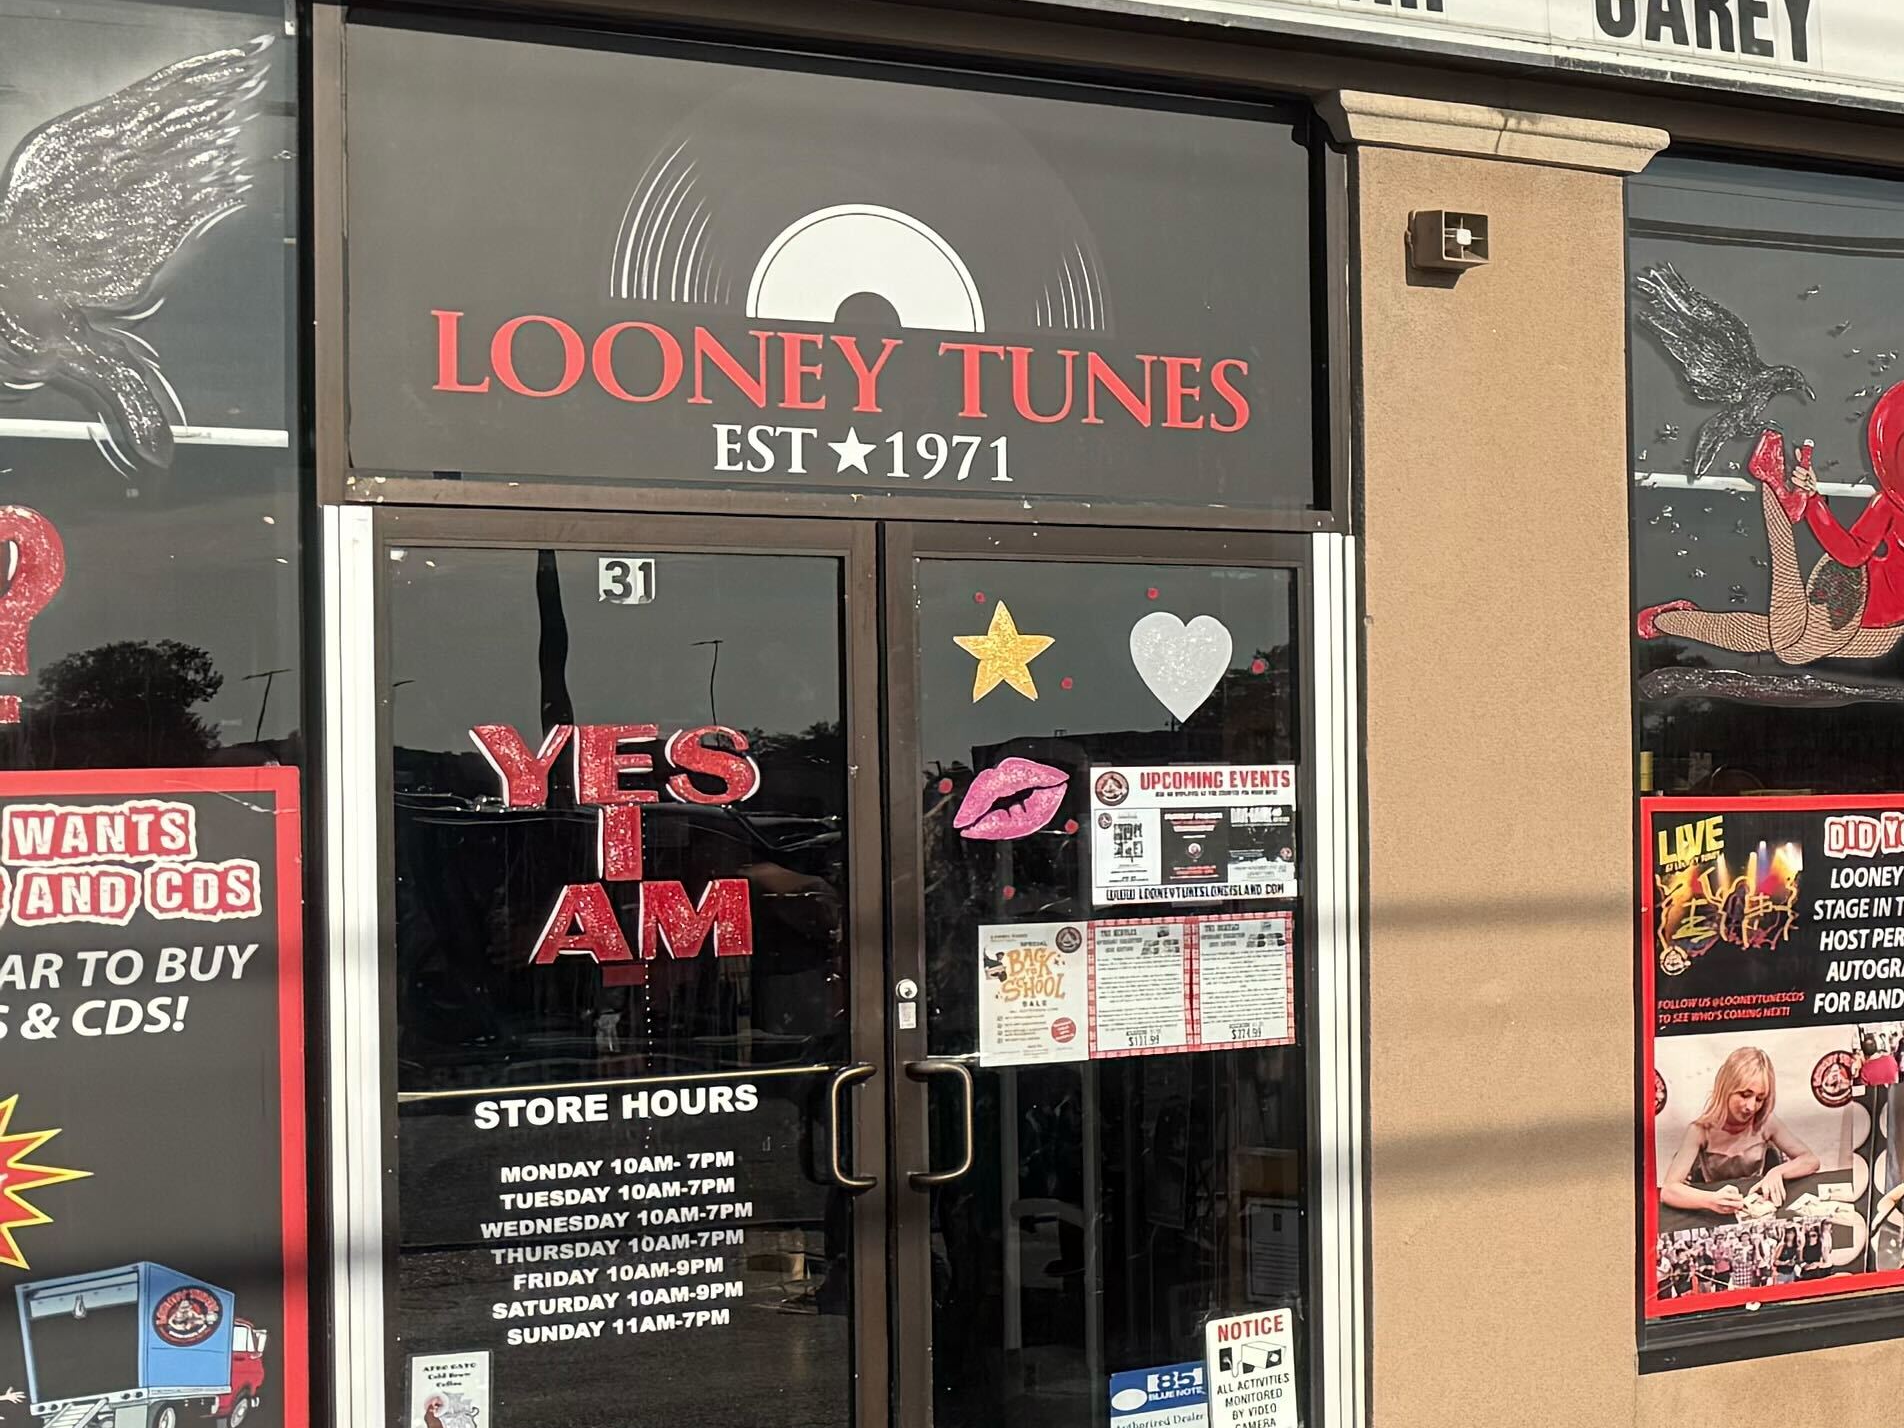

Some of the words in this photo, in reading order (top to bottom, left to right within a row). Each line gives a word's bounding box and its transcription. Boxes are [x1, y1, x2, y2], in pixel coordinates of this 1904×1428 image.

[429, 309, 904, 415] LOONEY
[937, 341, 1250, 433] TUNES
[711, 423, 818, 475] EST
[885, 430, 1014, 483] 1971
[602, 559, 655, 603] 31
[468, 723, 761, 808] YES
[1139, 770, 1224, 791] UPCOMING
[1229, 769, 1291, 789] EVENTS
[11, 809, 191, 858] WANTS
[597, 804, 643, 882] I
[1658, 814, 1725, 865] LIVE
[1828, 819, 1880, 853] DID
[25, 871, 132, 916] AND
[148, 866, 256, 912] CDS
[1830, 865, 1904, 890] LOONEY
[528, 878, 753, 965] AM
[1813, 895, 1871, 921] STAGE
[1873, 895, 1894, 918] IN
[1819, 927, 1871, 952] HOST
[77, 948, 146, 988] TO
[155, 943, 259, 984] BUY
[1006, 947, 1057, 978] BACK
[1001, 972, 1066, 1003] SCHOOL
[1658, 997, 1698, 1010] FOLLOW
[1813, 992, 1851, 1015] FOR
[20, 1001, 61, 1040] &
[71, 995, 190, 1037] CDS!
[473, 1093, 609, 1130] STORE
[621, 1083, 759, 1120] HOURS
[500, 1159, 603, 1184] MONDAY
[610, 1154, 681, 1176] 10AM-
[687, 1150, 735, 1171] 7PM
[499, 1186, 611, 1211] TUESDAY
[618, 1177, 735, 1202] 10AM-7PM
[480, 1211, 630, 1239] WEDNESDAY
[637, 1201, 753, 1227] 10AM-7PM
[490, 1239, 620, 1266] THURSDAY
[628, 1228, 745, 1254] 10AM-7PM
[513, 1267, 599, 1291] FRIDAY
[606, 1256, 724, 1281] 10AM-9PM
[492, 1292, 620, 1320] SATURDAY
[626, 1280, 744, 1307] 10AM-9PM
[507, 1320, 605, 1346] SUNDAY
[612, 1308, 730, 1335] 11AM-7PM
[1217, 1314, 1285, 1343] NOTICE
[1216, 1383, 1235, 1395] ALL
[1236, 1372, 1290, 1392] ACTIVITIES
[1224, 1387, 1283, 1408] MONITORED
[1172, 1411, 1204, 1426] Dealer
[1231, 1409, 1245, 1421] BY
[1248, 1402, 1278, 1417] VIDEO
